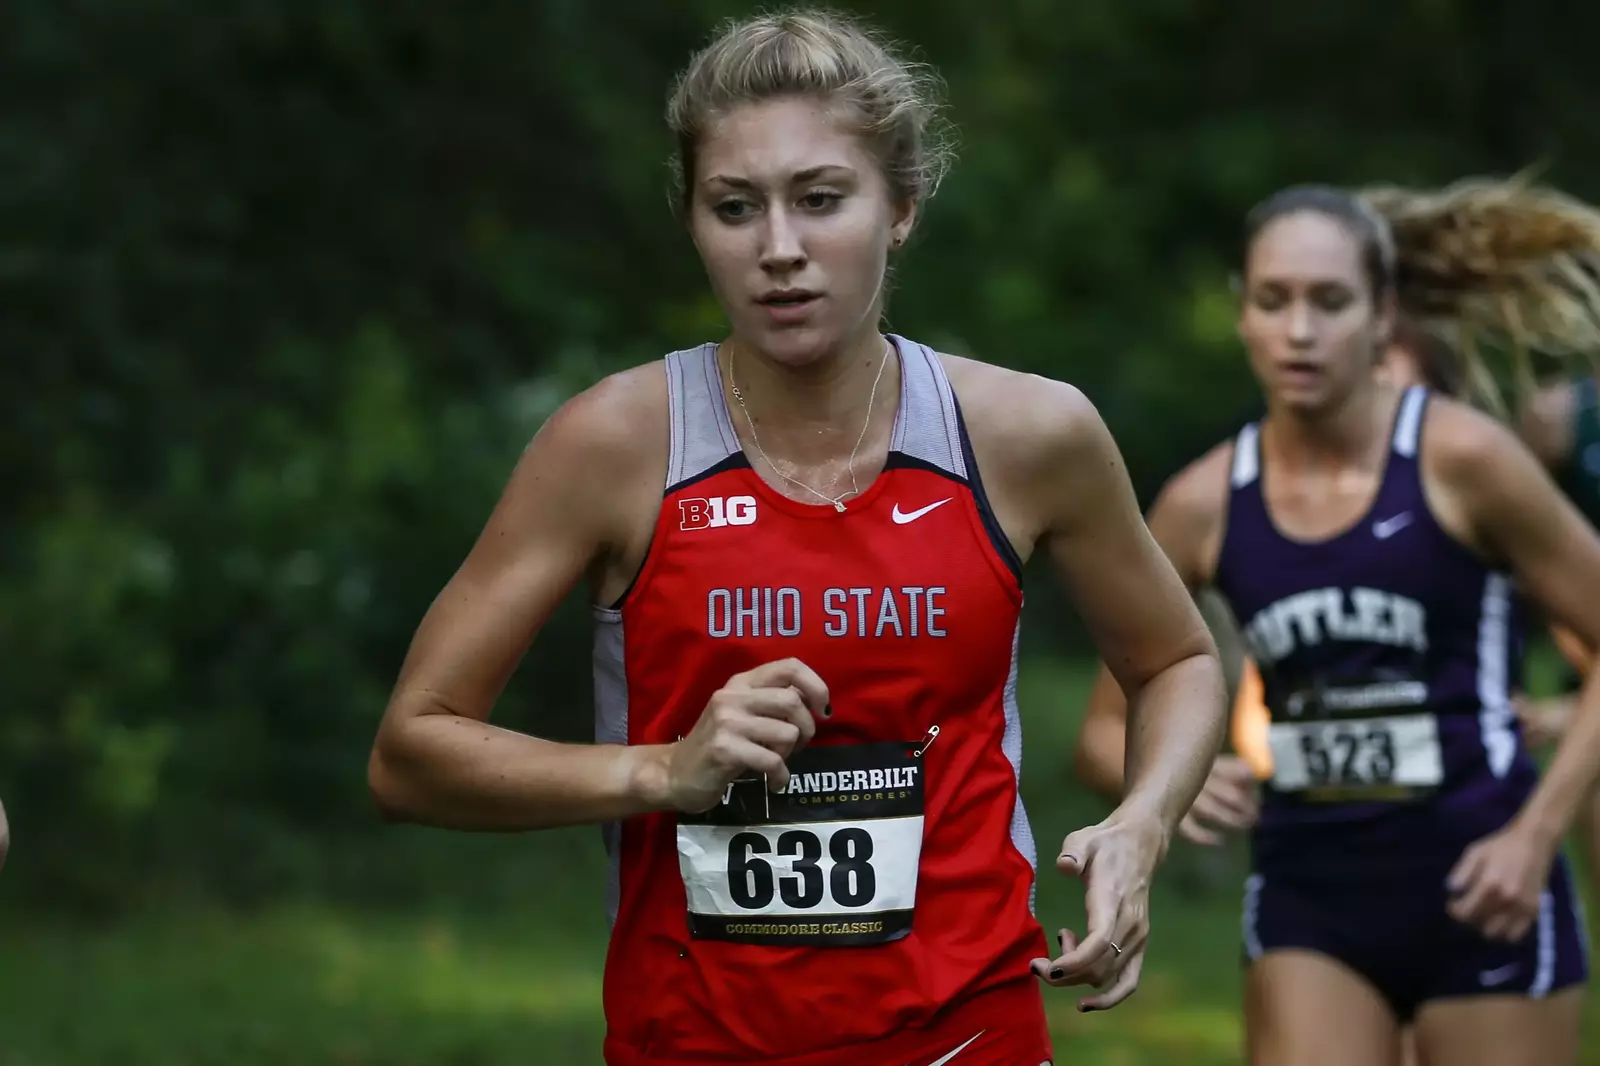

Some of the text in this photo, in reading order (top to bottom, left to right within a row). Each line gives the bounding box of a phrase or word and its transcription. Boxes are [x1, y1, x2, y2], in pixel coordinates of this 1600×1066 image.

[707, 586, 948, 638] OHIO STATE
[777, 766, 918, 794] ANDERBILT
[727, 827, 876, 910] 638
[726, 921, 883, 935] COMMODORE CLASSIC
